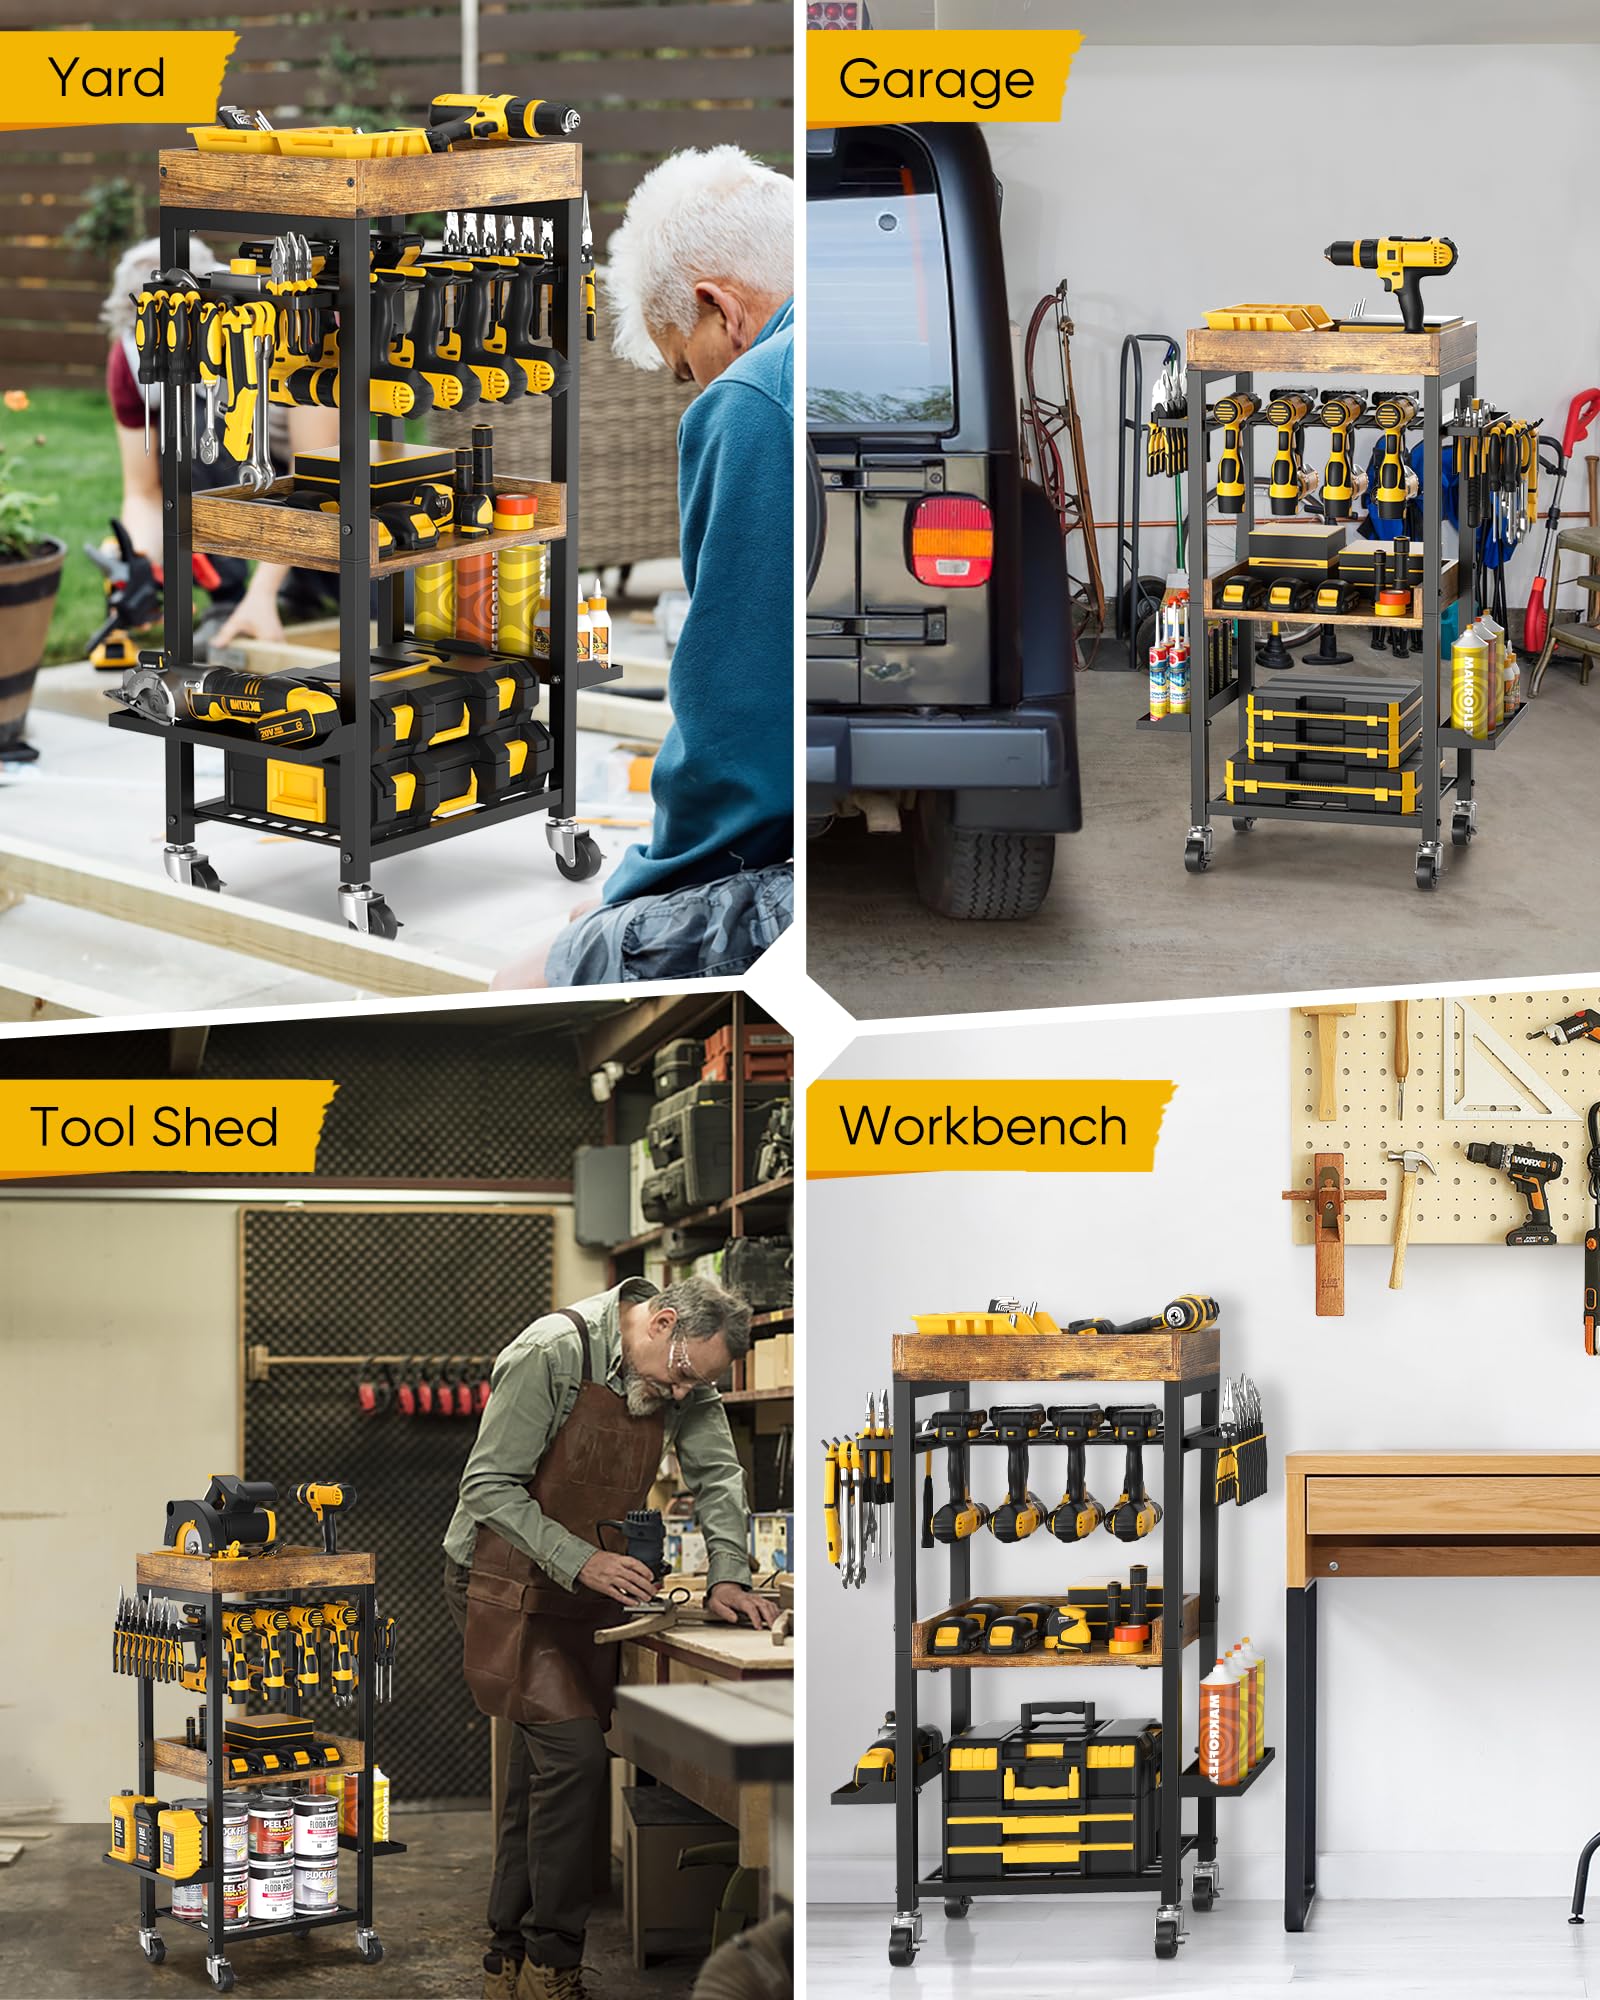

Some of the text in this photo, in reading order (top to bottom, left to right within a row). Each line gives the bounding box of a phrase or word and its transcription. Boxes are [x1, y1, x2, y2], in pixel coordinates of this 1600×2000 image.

[1463, 656, 1475, 737] MAKROFLEX
[260, 728, 274, 739] 20V
[1514, 1155, 1542, 1168] WORX
[263, 1819, 282, 1829] PEEL
[309, 1820, 327, 1829] FLOOR
[305, 1871, 327, 1879] BLOCK
[264, 1883, 282, 1892] FLOOR
